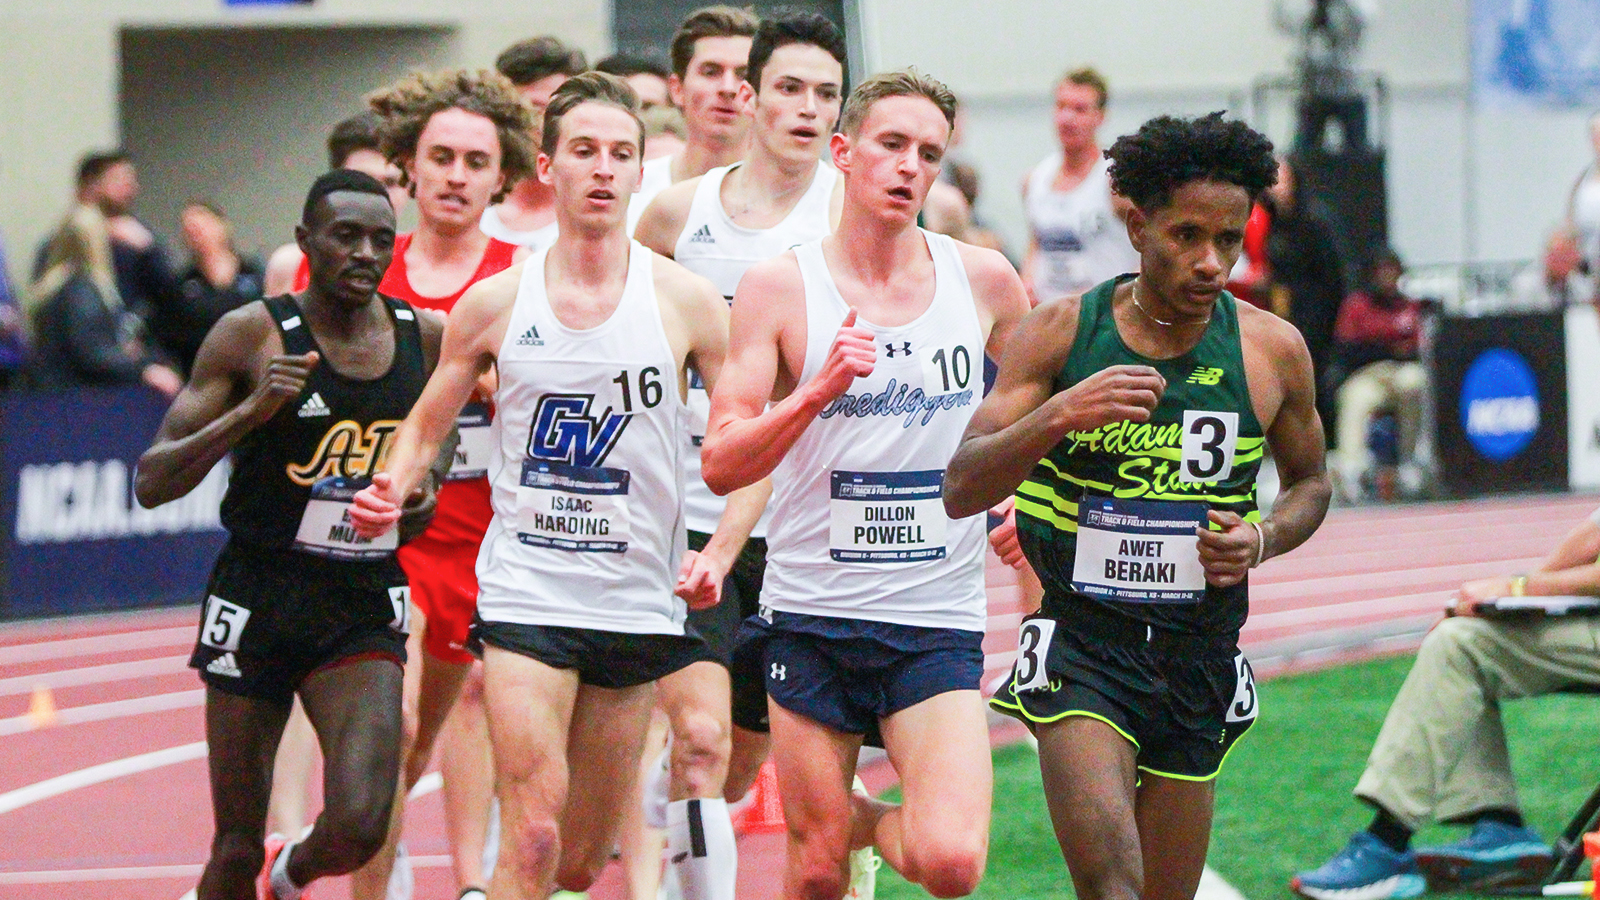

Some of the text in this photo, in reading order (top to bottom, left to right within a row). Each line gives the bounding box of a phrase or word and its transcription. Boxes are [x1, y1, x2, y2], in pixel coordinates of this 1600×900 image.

[931, 344, 970, 392] 10
[612, 366, 663, 413] 16
[1065, 419, 1183, 455] Adam
[1187, 416, 1227, 479] 3
[551, 495, 593, 513] ISAAC
[864, 506, 915, 522] DILLON
[534, 513, 610, 536] HARDING
[1101, 515, 1121, 525] TRACK
[1127, 518, 1145, 527] FIELD
[1145, 519, 1200, 528] CHAMPIONSHIPS
[853, 525, 926, 545] POWELL
[1118, 538, 1164, 558] AWET
[1104, 558, 1176, 584] BERAKI
[1016, 624, 1041, 687] 3
[1233, 656, 1255, 719] 3
